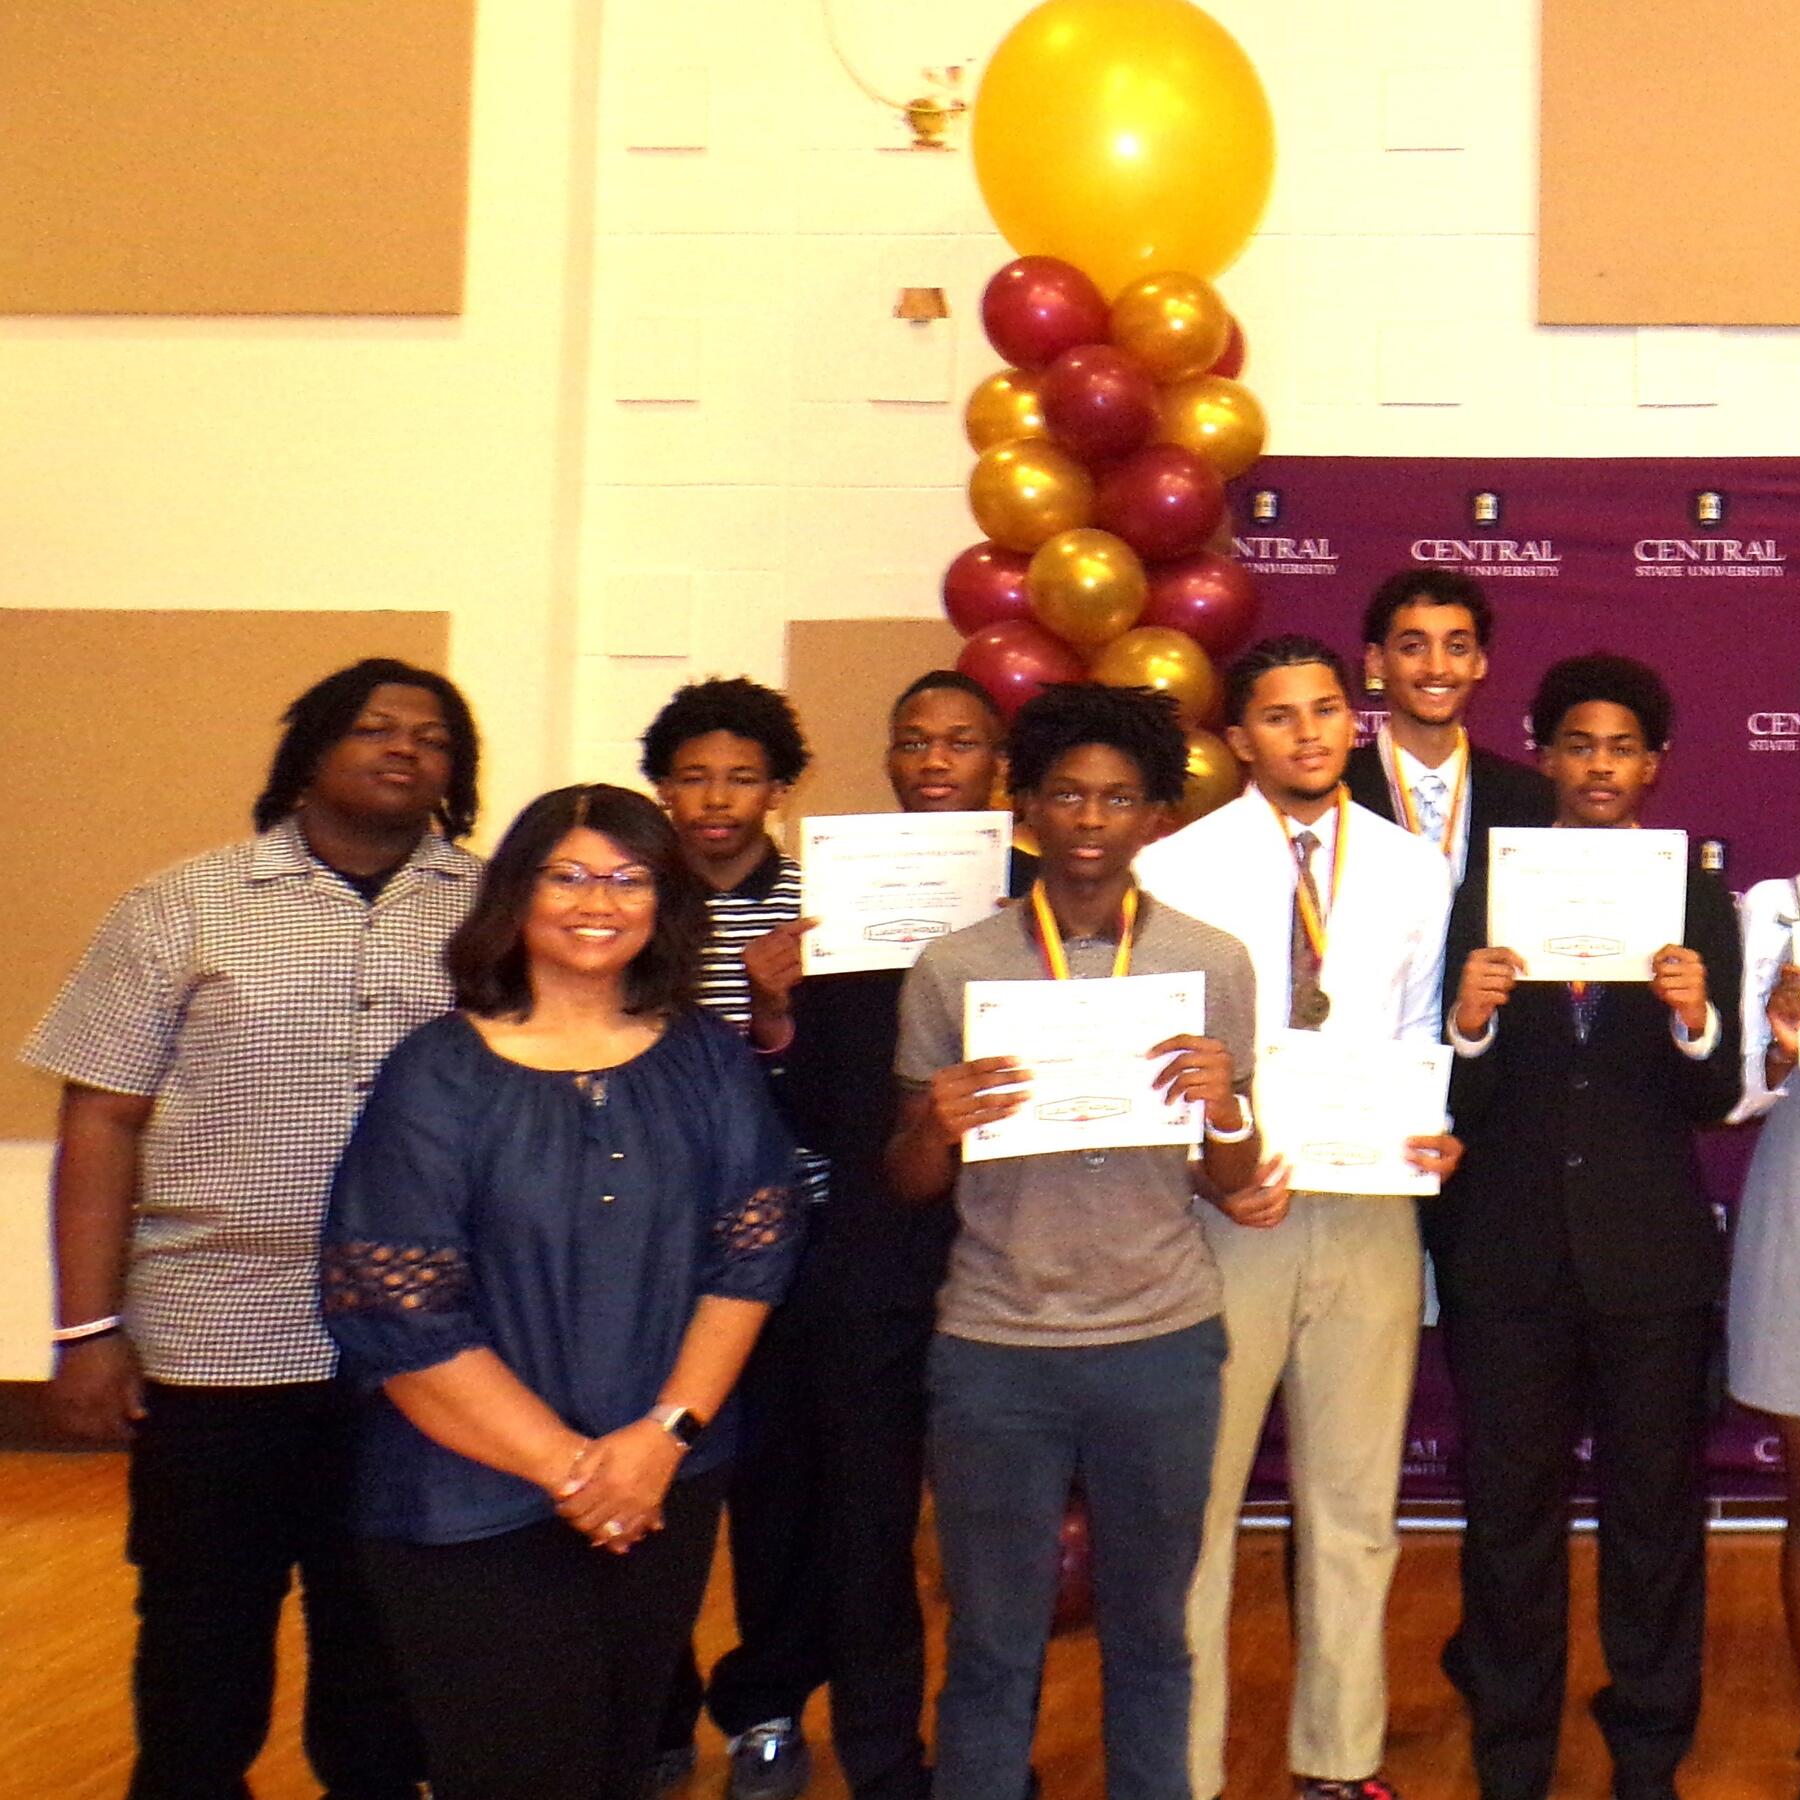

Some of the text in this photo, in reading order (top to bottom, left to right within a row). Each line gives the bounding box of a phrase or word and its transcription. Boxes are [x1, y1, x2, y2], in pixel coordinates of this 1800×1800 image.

[1231, 537, 1339, 559] NTRAL
[1411, 539, 1562, 561] CENTRAL
[1634, 539, 1787, 562] CENTRAL
[1635, 565, 1784, 577] STATE UNIVERSITY
[1749, 740, 1799, 751] STATE
